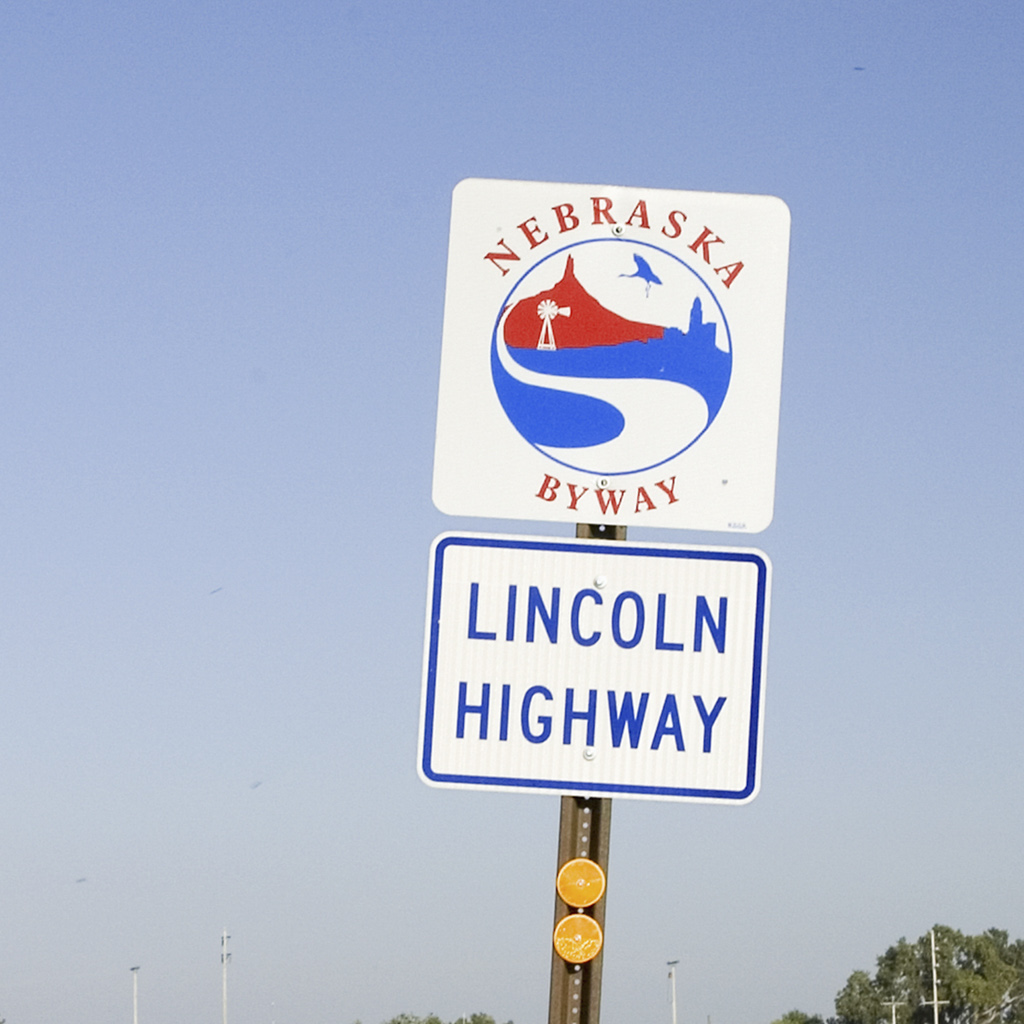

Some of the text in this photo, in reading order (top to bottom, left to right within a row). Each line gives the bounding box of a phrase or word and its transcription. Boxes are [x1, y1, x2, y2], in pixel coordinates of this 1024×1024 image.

[483, 196, 745, 289] NEBRASKA
[535, 473, 680, 516] BYWAY
[467, 582, 729, 654] LINCOLN
[455, 681, 728, 754] HIGHWAY
